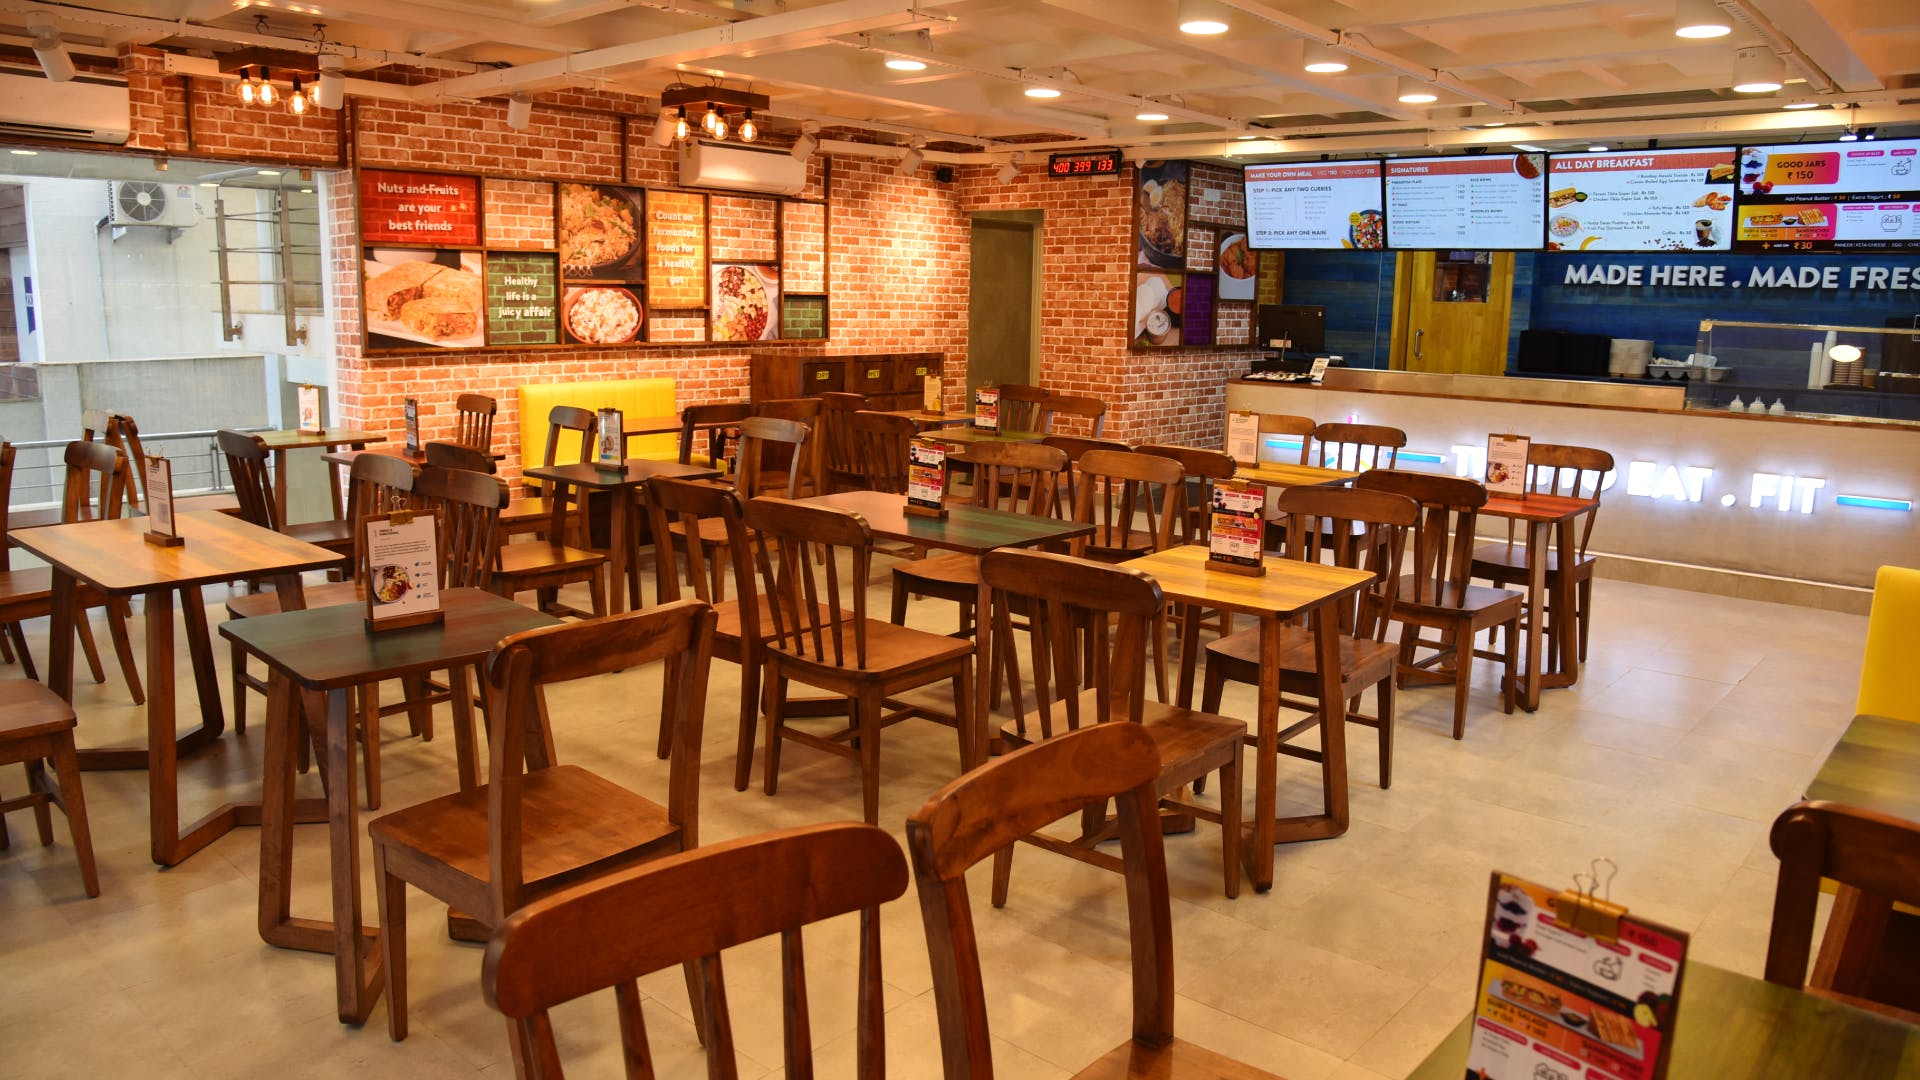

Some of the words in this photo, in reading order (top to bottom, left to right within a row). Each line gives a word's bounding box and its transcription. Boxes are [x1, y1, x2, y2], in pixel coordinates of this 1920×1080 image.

[1053, 162, 1070, 173] 400
[1074, 161, 1092, 172] 399
[1097, 160, 1113, 171] 133
[1391, 166, 1429, 174] SIGNATURES
[1555, 161, 1573, 170] ALL
[1575, 160, 1594, 169] DAY
[1597, 158, 1655, 168] BREAKFAST
[1776, 160, 1803, 169] GOOD
[1805, 160, 1827, 168] JARS
[1795, 170, 1814, 179] 150
[377, 182, 404, 193] Nuts
[406, 184, 426, 194] and
[428, 184, 460, 196] Fruits
[398, 204, 415, 212] are
[417, 204, 442, 216] your
[656, 210, 681, 220] Count
[388, 219, 413, 230] best
[415, 220, 453, 231] friends
[653, 226, 697, 237] fermented
[656, 242, 680, 252] foods
[681, 243, 694, 252] for
[504, 276, 538, 288] Healthy
[1564, 264, 1643, 286] MADE
[1650, 265, 1726, 287] HERE
[1748, 266, 1840, 289] MADE
[505, 291, 520, 301] life
[522, 291, 530, 301] is
[498, 307, 521, 320] juicy
[523, 306, 552, 317] affair
[1627, 460, 1713, 503] EAT
[1749, 472, 1826, 515] FIT
